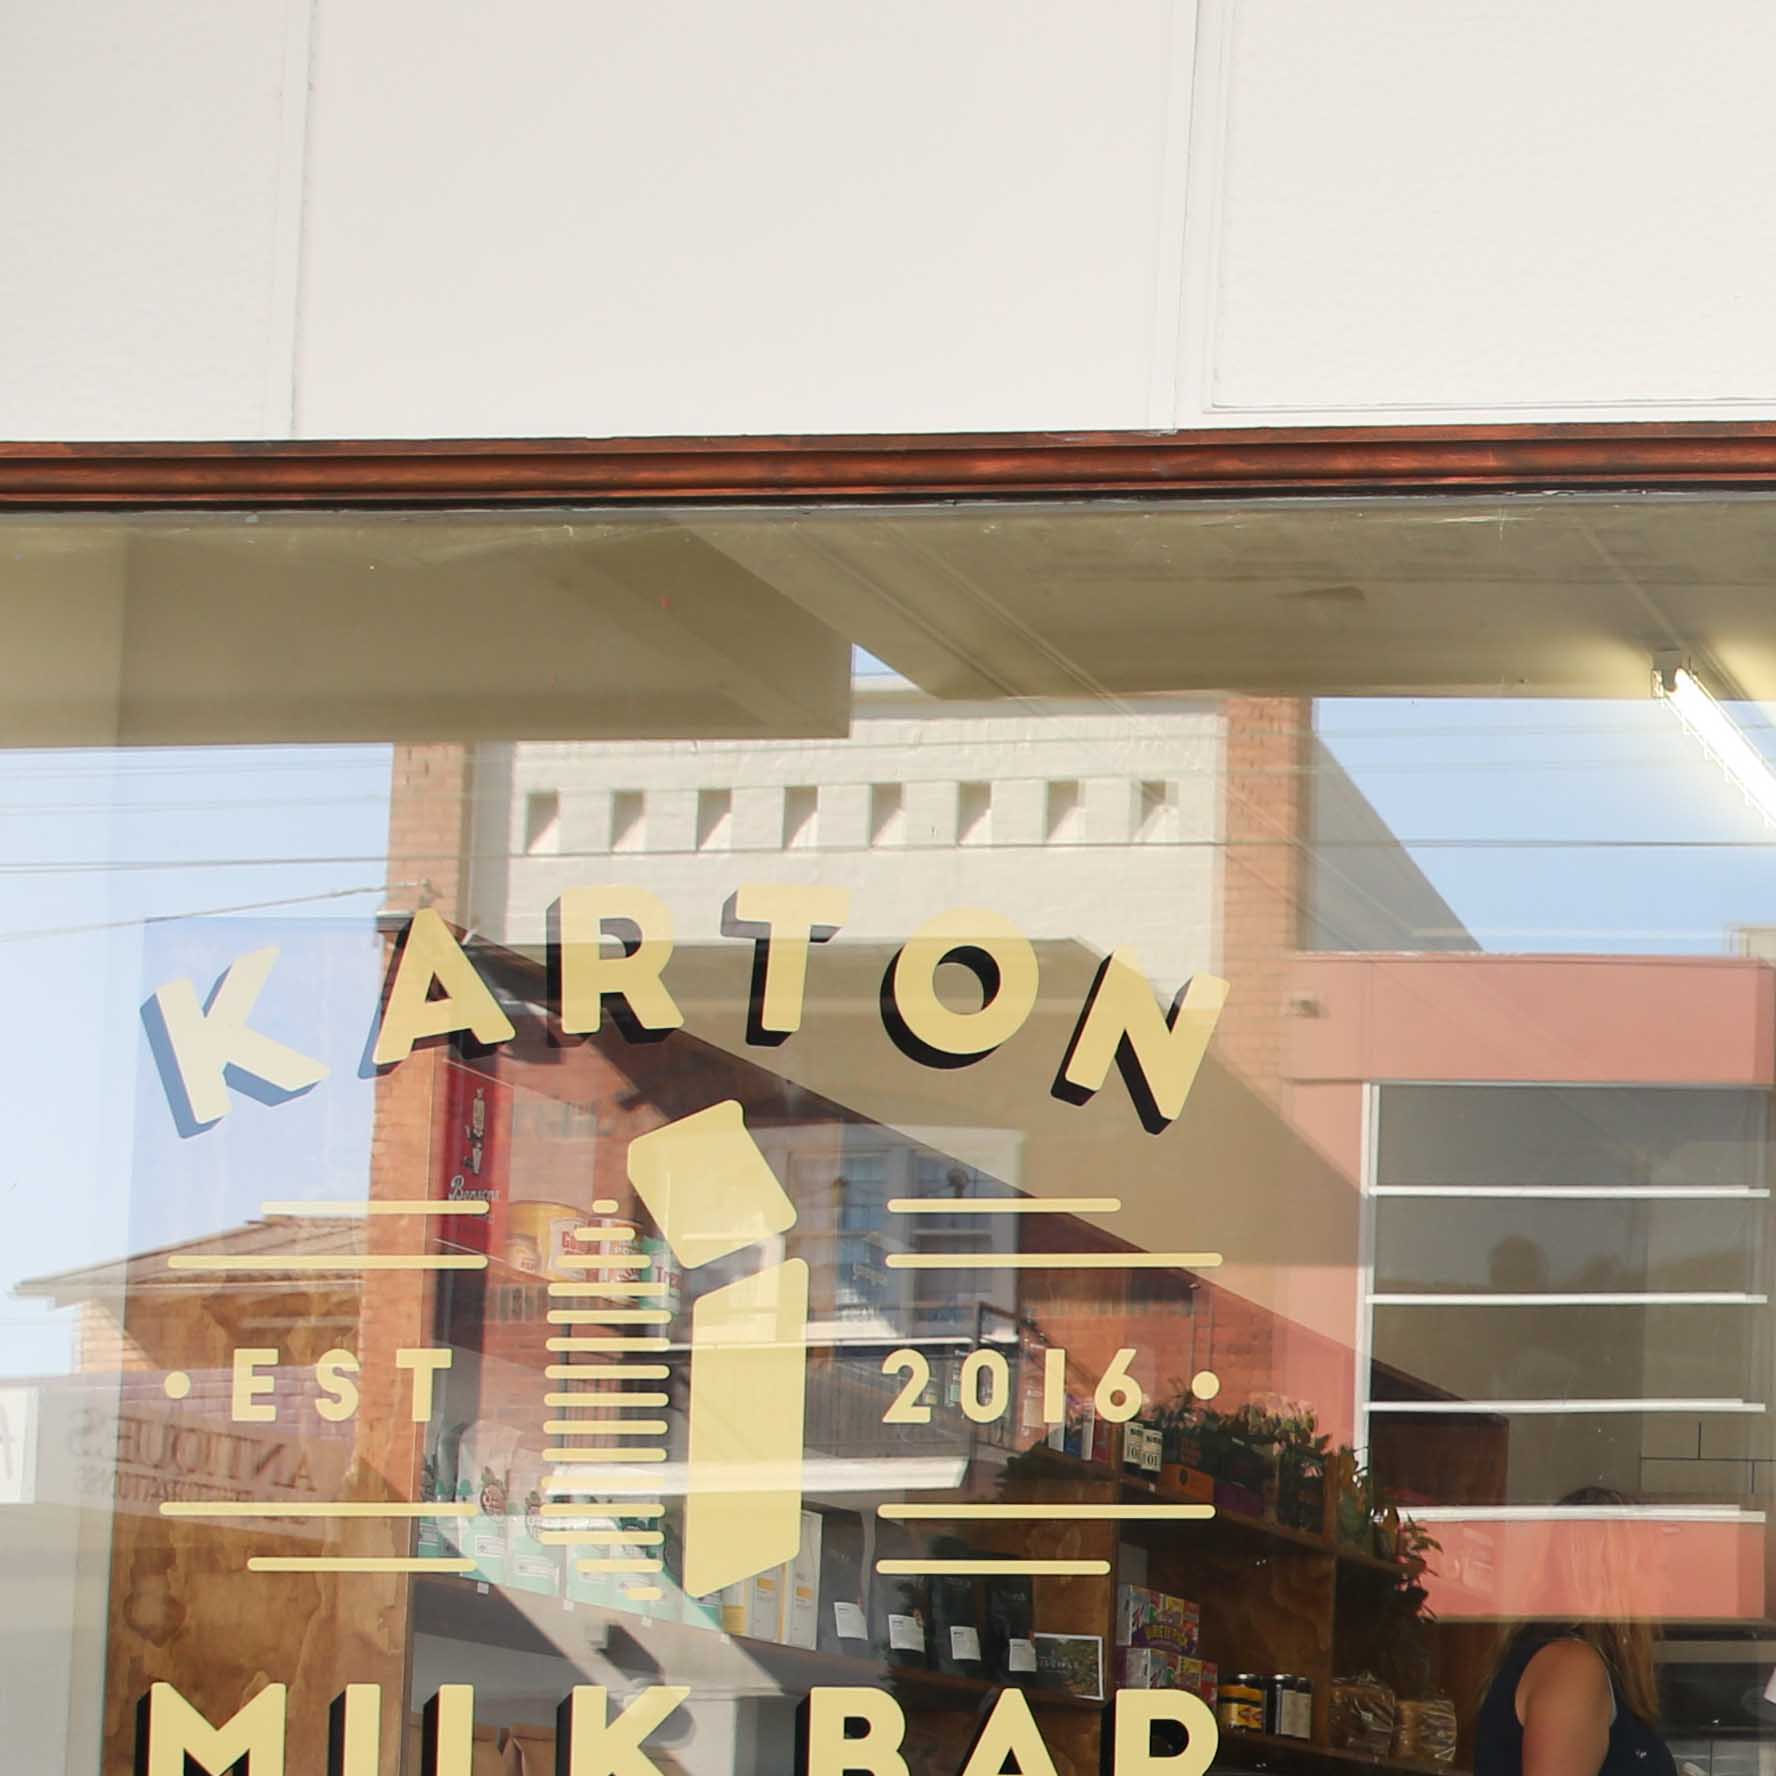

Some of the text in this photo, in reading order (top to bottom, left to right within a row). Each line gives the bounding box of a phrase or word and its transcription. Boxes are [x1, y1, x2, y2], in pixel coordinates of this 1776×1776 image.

[140, 884, 1231, 1138] KARTON
[231, 1347, 453, 1424] EST
[881, 1348, 1143, 1425] 2016
